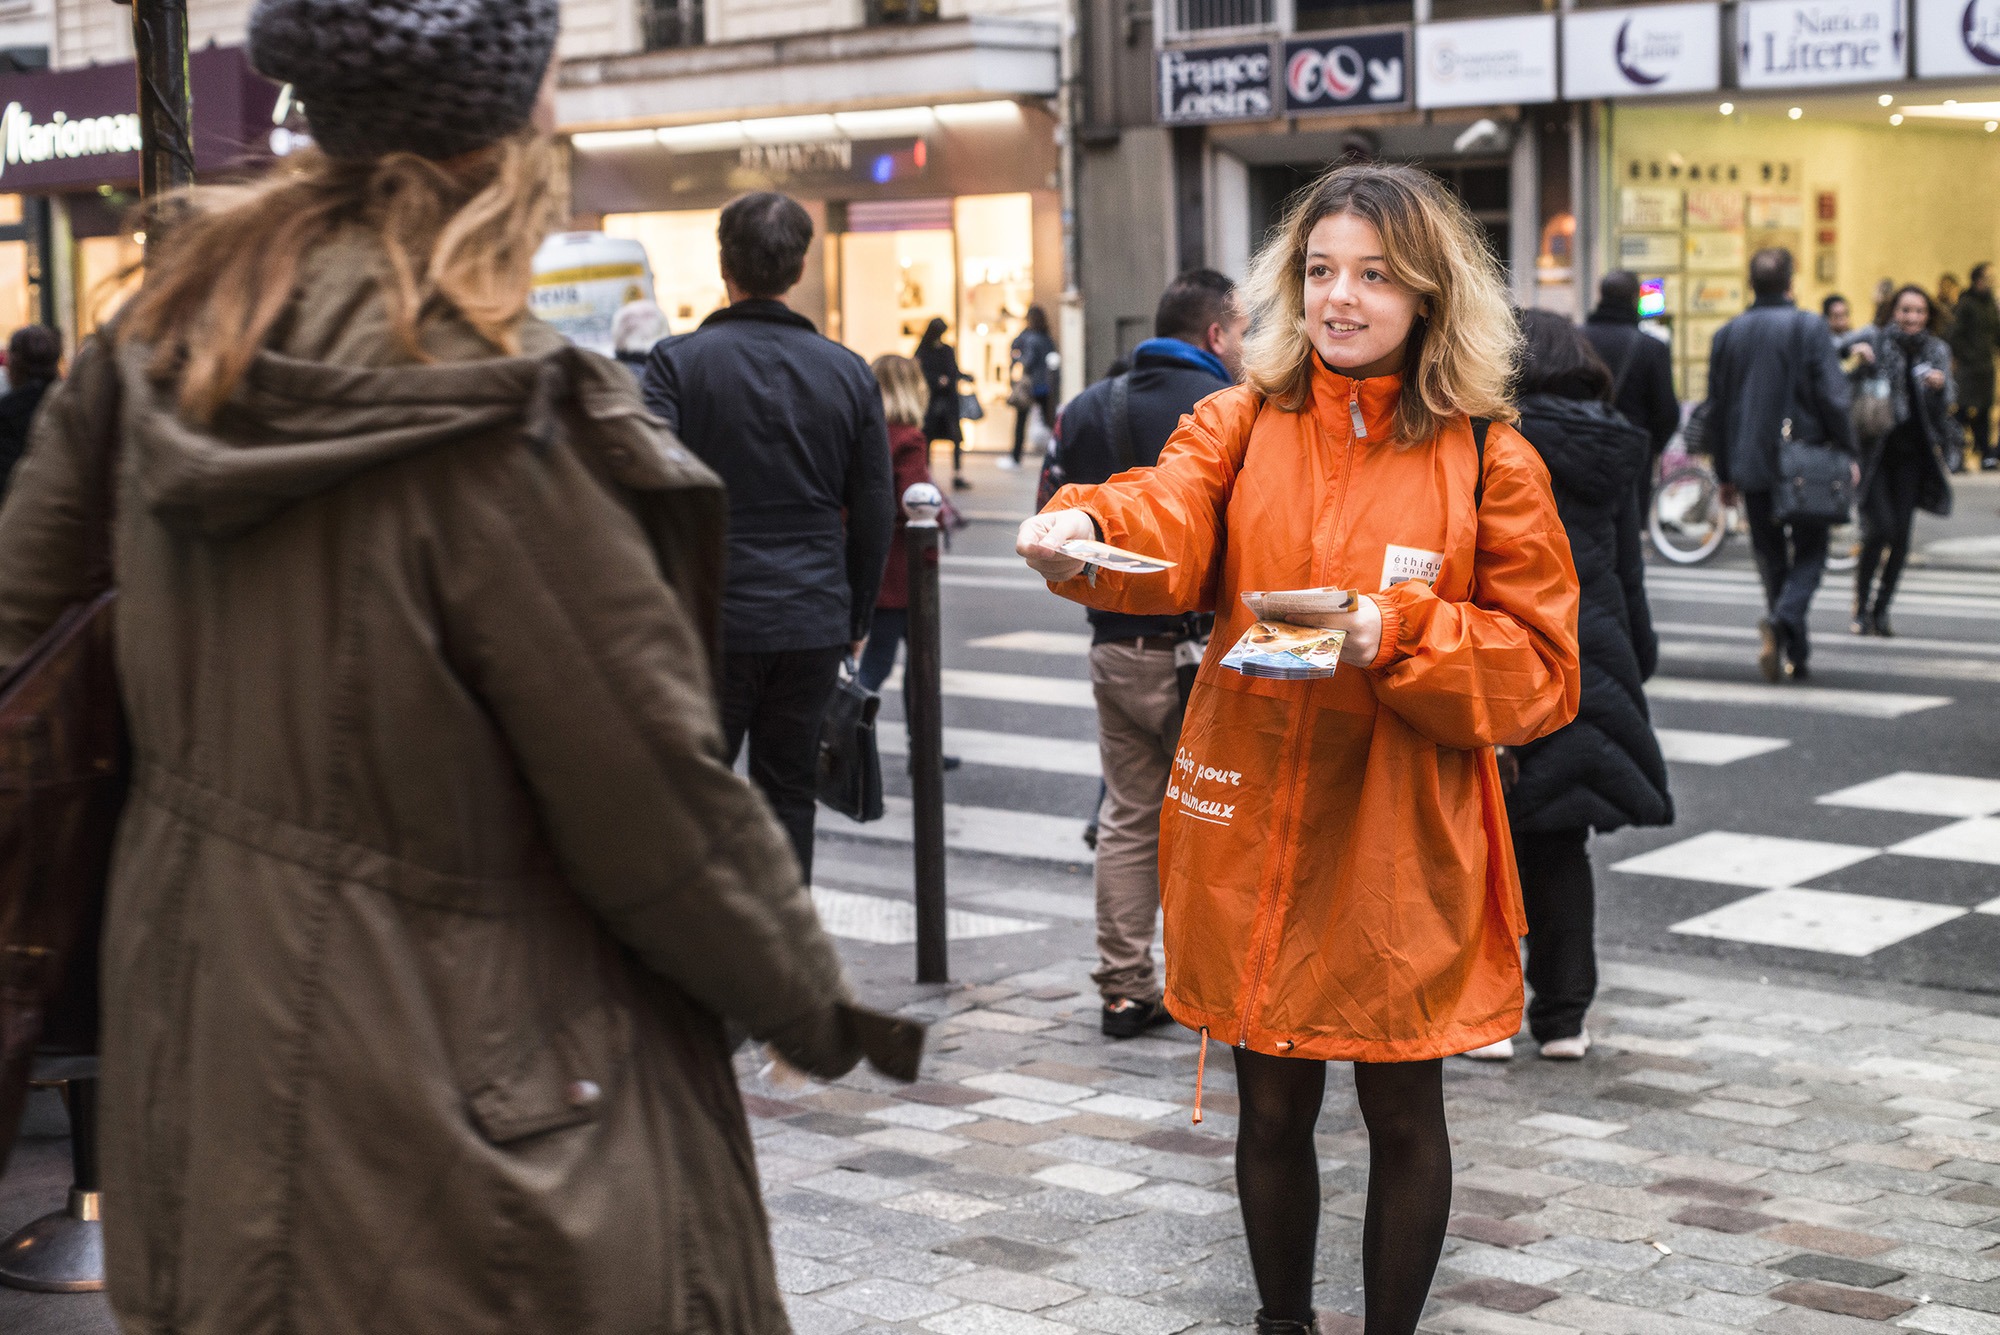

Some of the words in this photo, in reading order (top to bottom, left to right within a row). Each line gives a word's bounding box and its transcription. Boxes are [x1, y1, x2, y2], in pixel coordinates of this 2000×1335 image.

[1161, 51, 1269, 88] France
[0, 101, 142, 178] Marionnau
[1394, 555, 1441, 571] éthiqu
[1402, 567, 1438, 577] anima
[1193, 764, 1242, 786] pour
